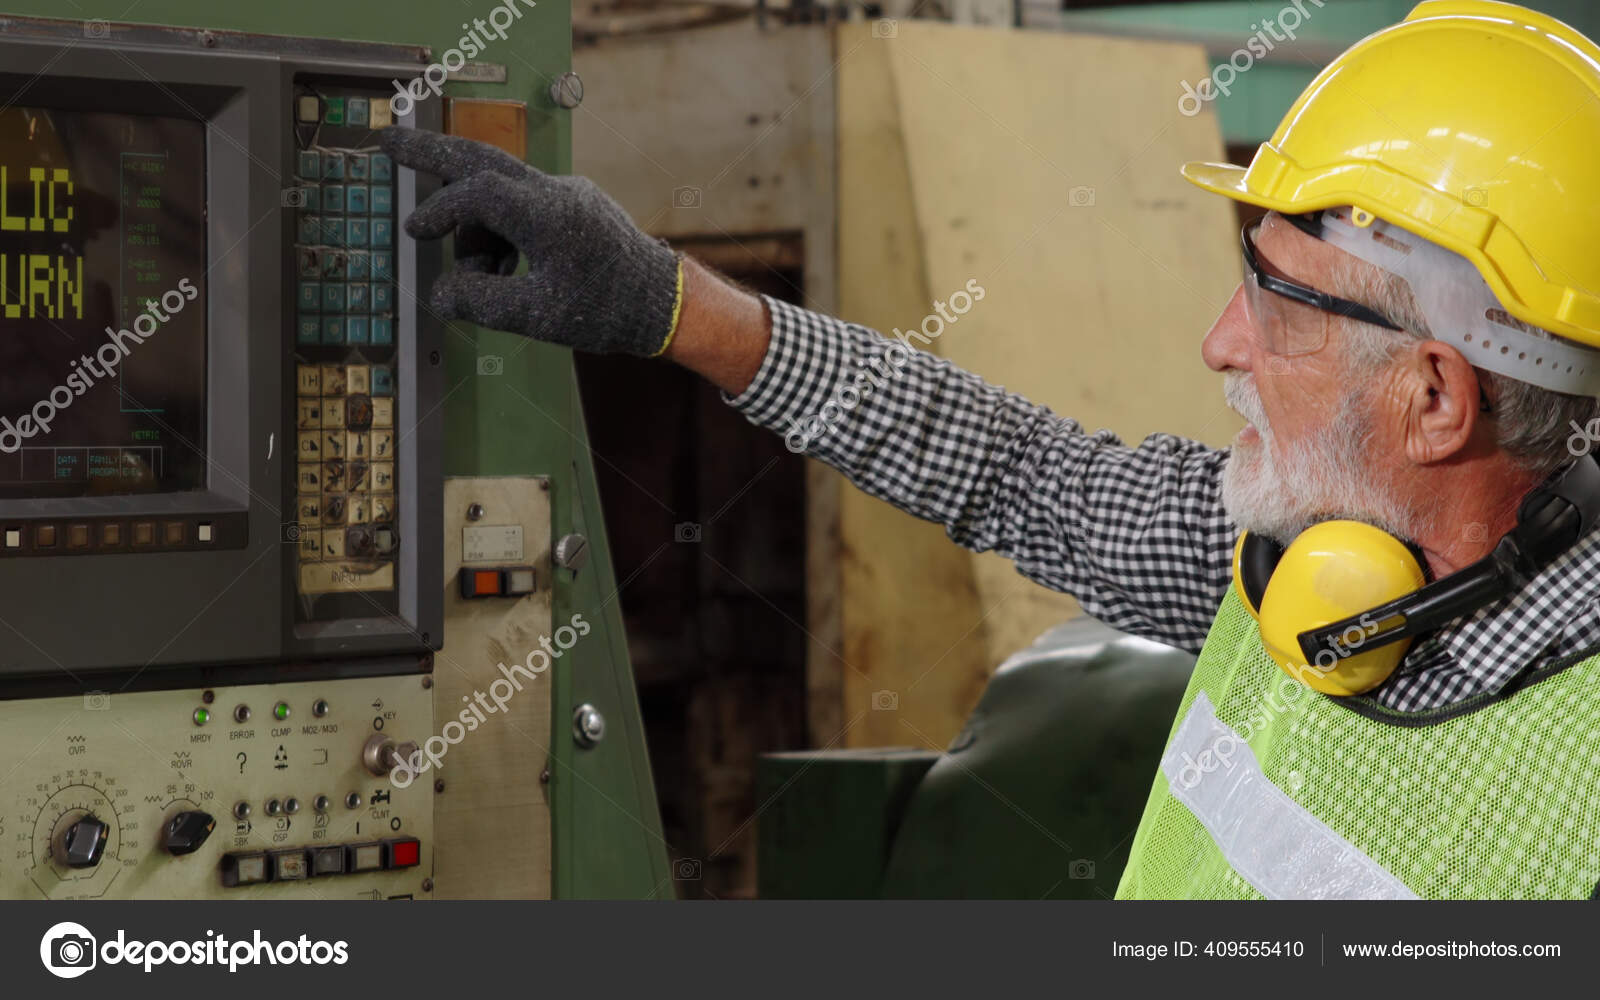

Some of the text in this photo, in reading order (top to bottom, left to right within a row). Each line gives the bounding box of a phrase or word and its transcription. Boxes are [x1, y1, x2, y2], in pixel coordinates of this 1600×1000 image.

[0, 166, 73, 232] LIC
[0, 254, 83, 320] URN
[383, 712, 397, 720] KEY
[190, 734, 212, 744] MRDY
[229, 730, 255, 740] ERROR
[271, 727, 292, 737] CLMP
[68, 745, 86, 755] OVR
[167, 784, 214, 800] 25 50 100
[371, 810, 390, 820] CLNT
